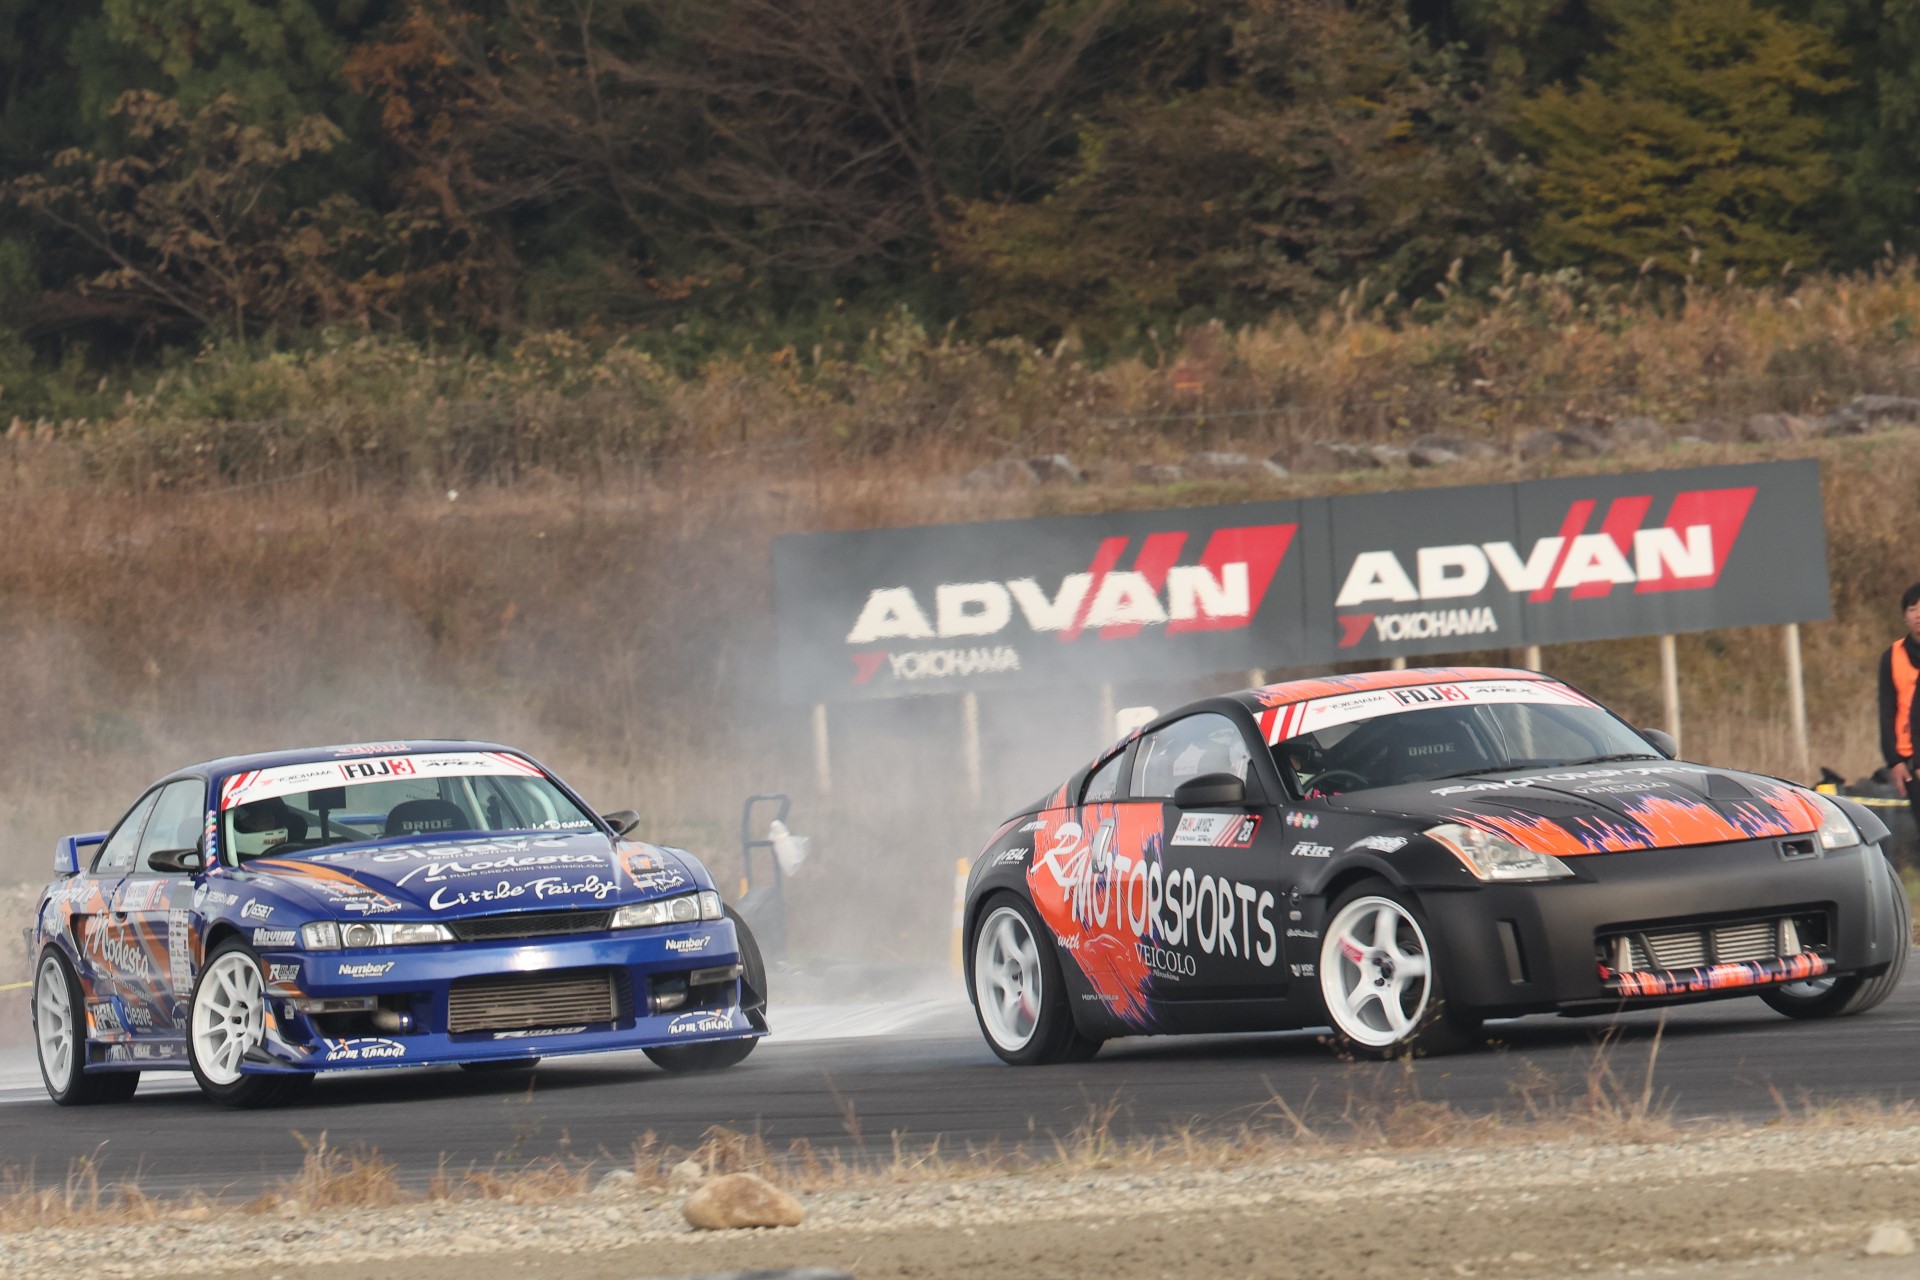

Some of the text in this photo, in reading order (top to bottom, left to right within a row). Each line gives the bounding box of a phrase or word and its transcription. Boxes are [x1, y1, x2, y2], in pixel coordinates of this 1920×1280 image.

[1335, 524, 1715, 607] ADVAN
[846, 561, 1249, 645] ADVAN
[1373, 606, 1498, 642] YOKOHAMA
[888, 645, 1021, 681] YOKOHAMA
[1408, 743, 1454, 756] BRIDE
[402, 819, 453, 831] BRIDE
[396, 851, 605, 887] Modesta
[83, 908, 151, 984] Modesta
[666, 936, 711, 951] Number7
[1057, 932, 1080, 951] with
[1133, 942, 1196, 976] VEICOLO
[338, 961, 395, 975] Number7
